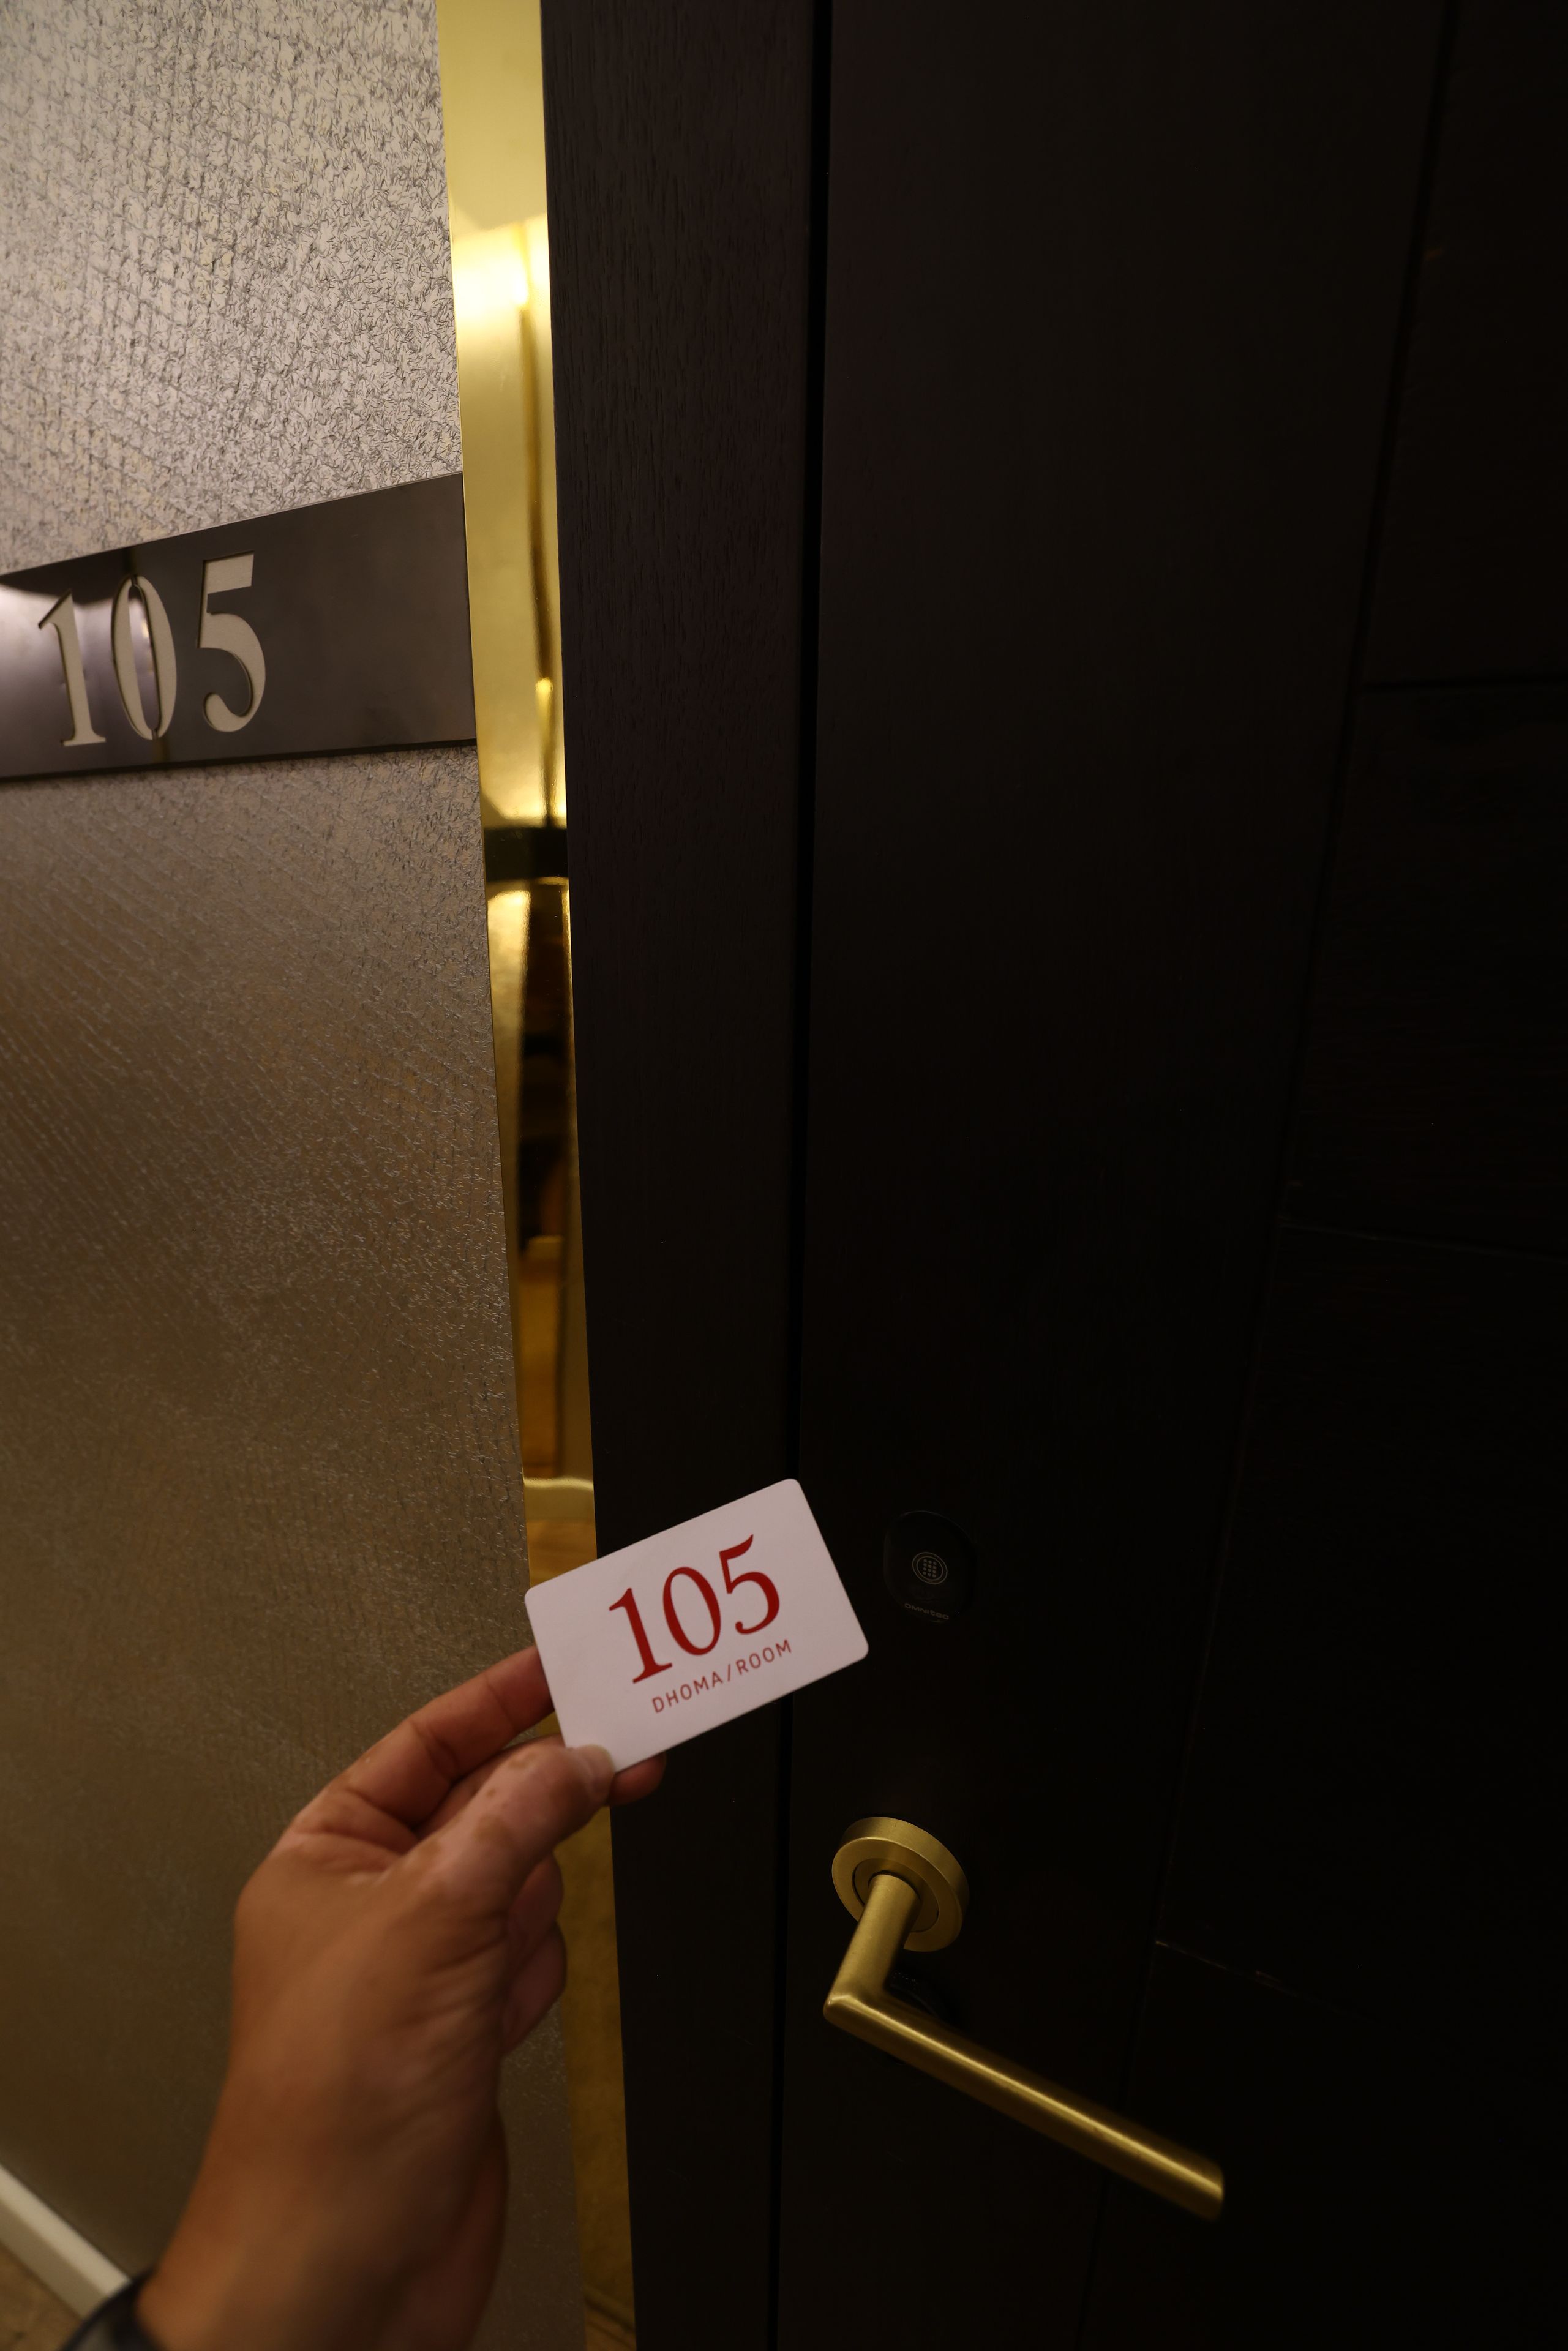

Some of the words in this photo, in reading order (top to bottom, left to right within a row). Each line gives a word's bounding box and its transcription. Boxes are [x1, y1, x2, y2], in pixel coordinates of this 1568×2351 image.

[39, 551, 266, 746] 105
[609, 1534, 779, 1683] 105
[652, 1639, 792, 1712] DHOMA/ROOM
